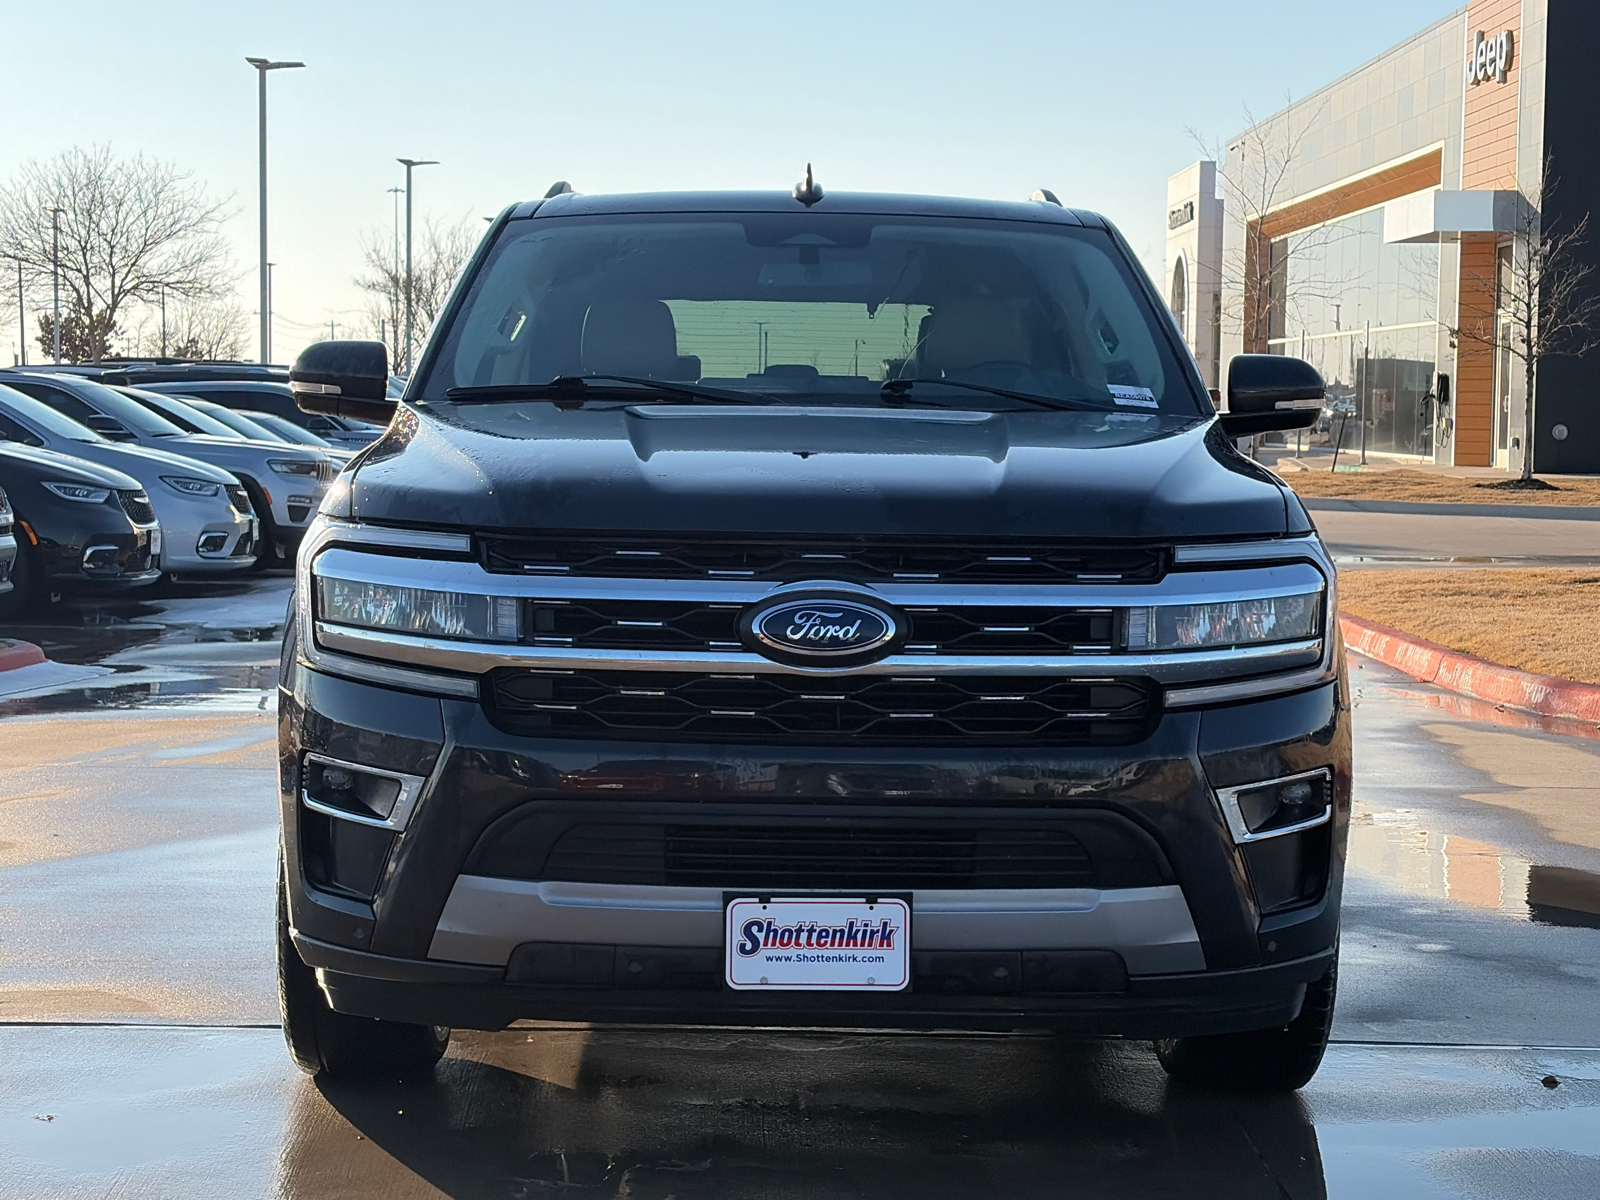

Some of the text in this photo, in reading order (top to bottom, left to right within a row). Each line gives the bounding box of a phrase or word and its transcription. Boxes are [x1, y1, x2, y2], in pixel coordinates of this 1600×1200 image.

[1466, 29, 1512, 85] Jeep
[786, 610, 862, 642] Ford
[737, 918, 899, 957] Shottenkirk
[765, 953, 885, 963] www.Shottenkirk.com
